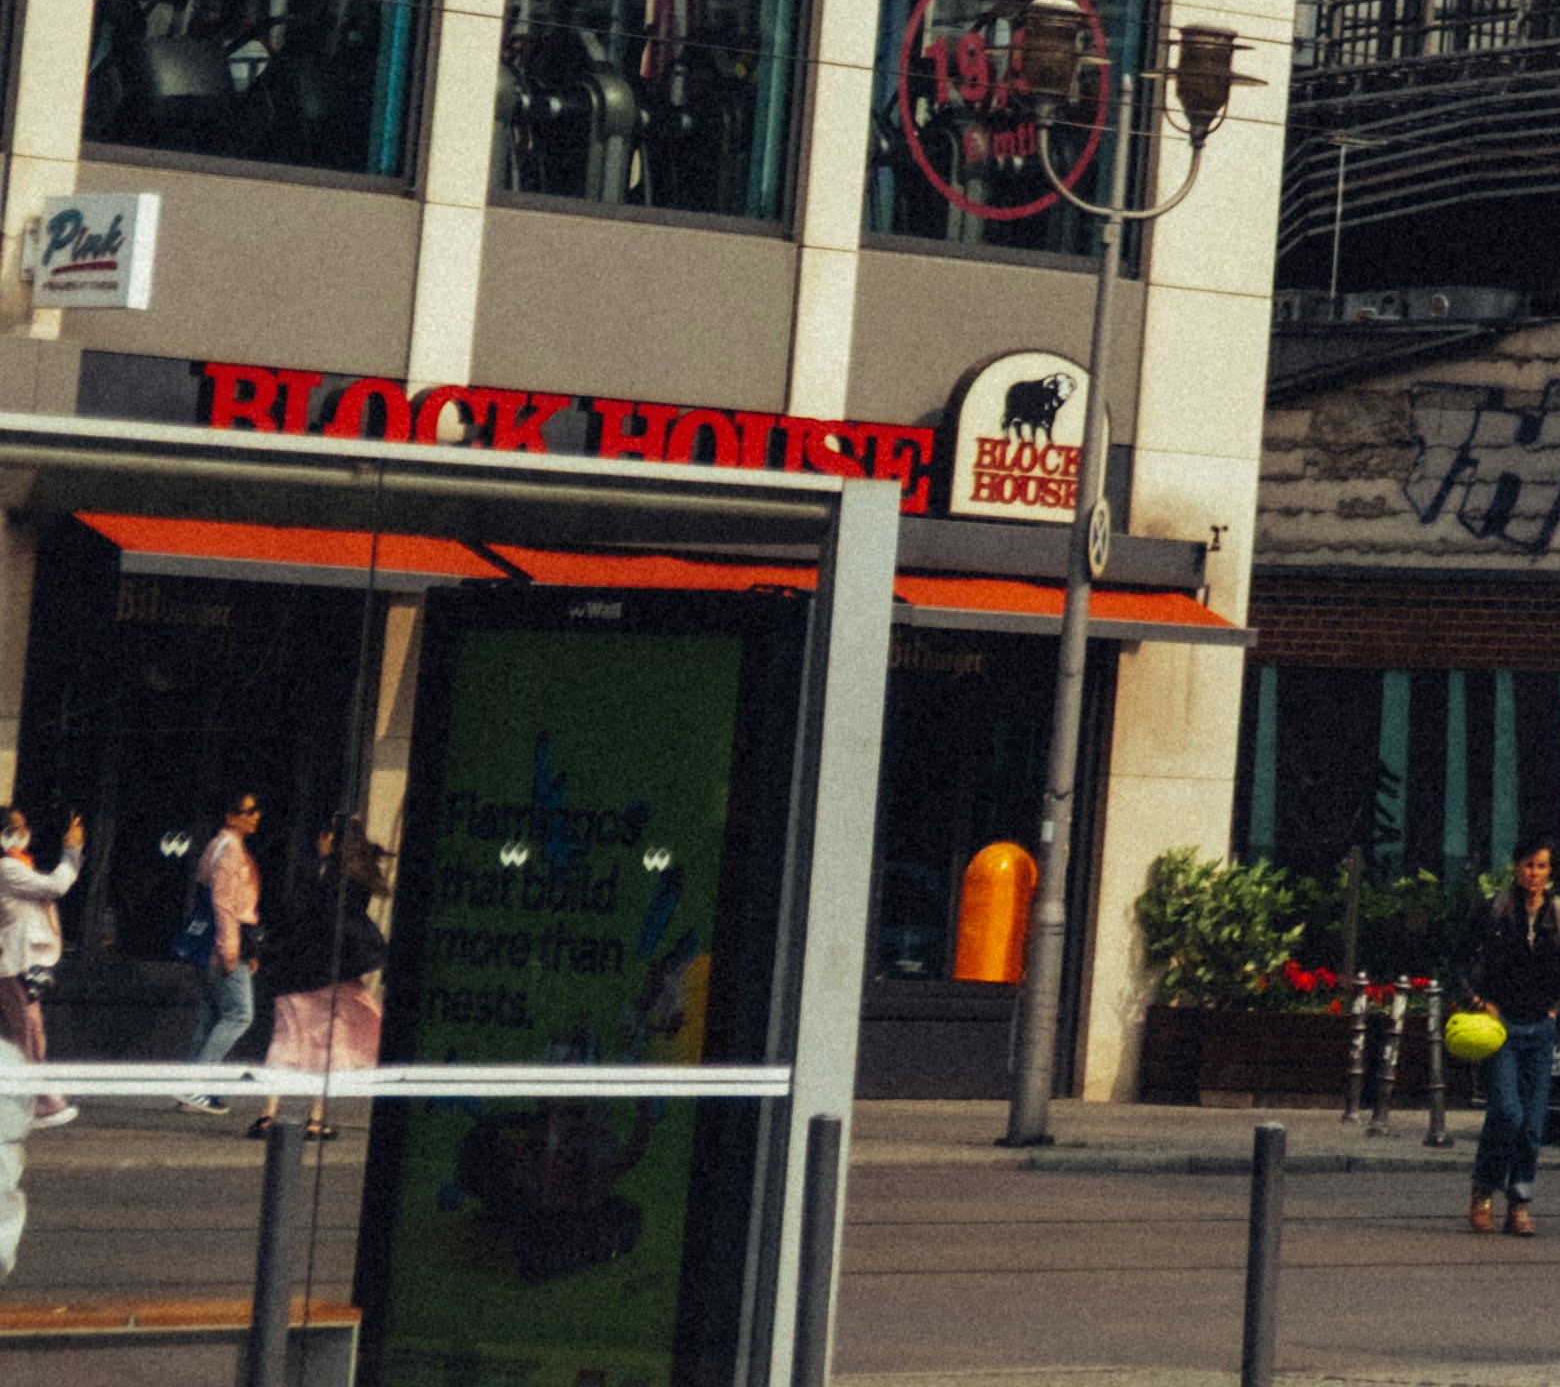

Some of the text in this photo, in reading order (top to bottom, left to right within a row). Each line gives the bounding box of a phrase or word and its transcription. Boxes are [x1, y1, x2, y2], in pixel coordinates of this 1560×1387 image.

[41, 208, 127, 267] Pink
[204, 360, 935, 515] BLOCK HOUSE
[445, 792, 646, 857] Flamingos
[440, 858, 619, 914] that build
[433, 923, 624, 975] more than
[425, 984, 533, 1030] nests.
